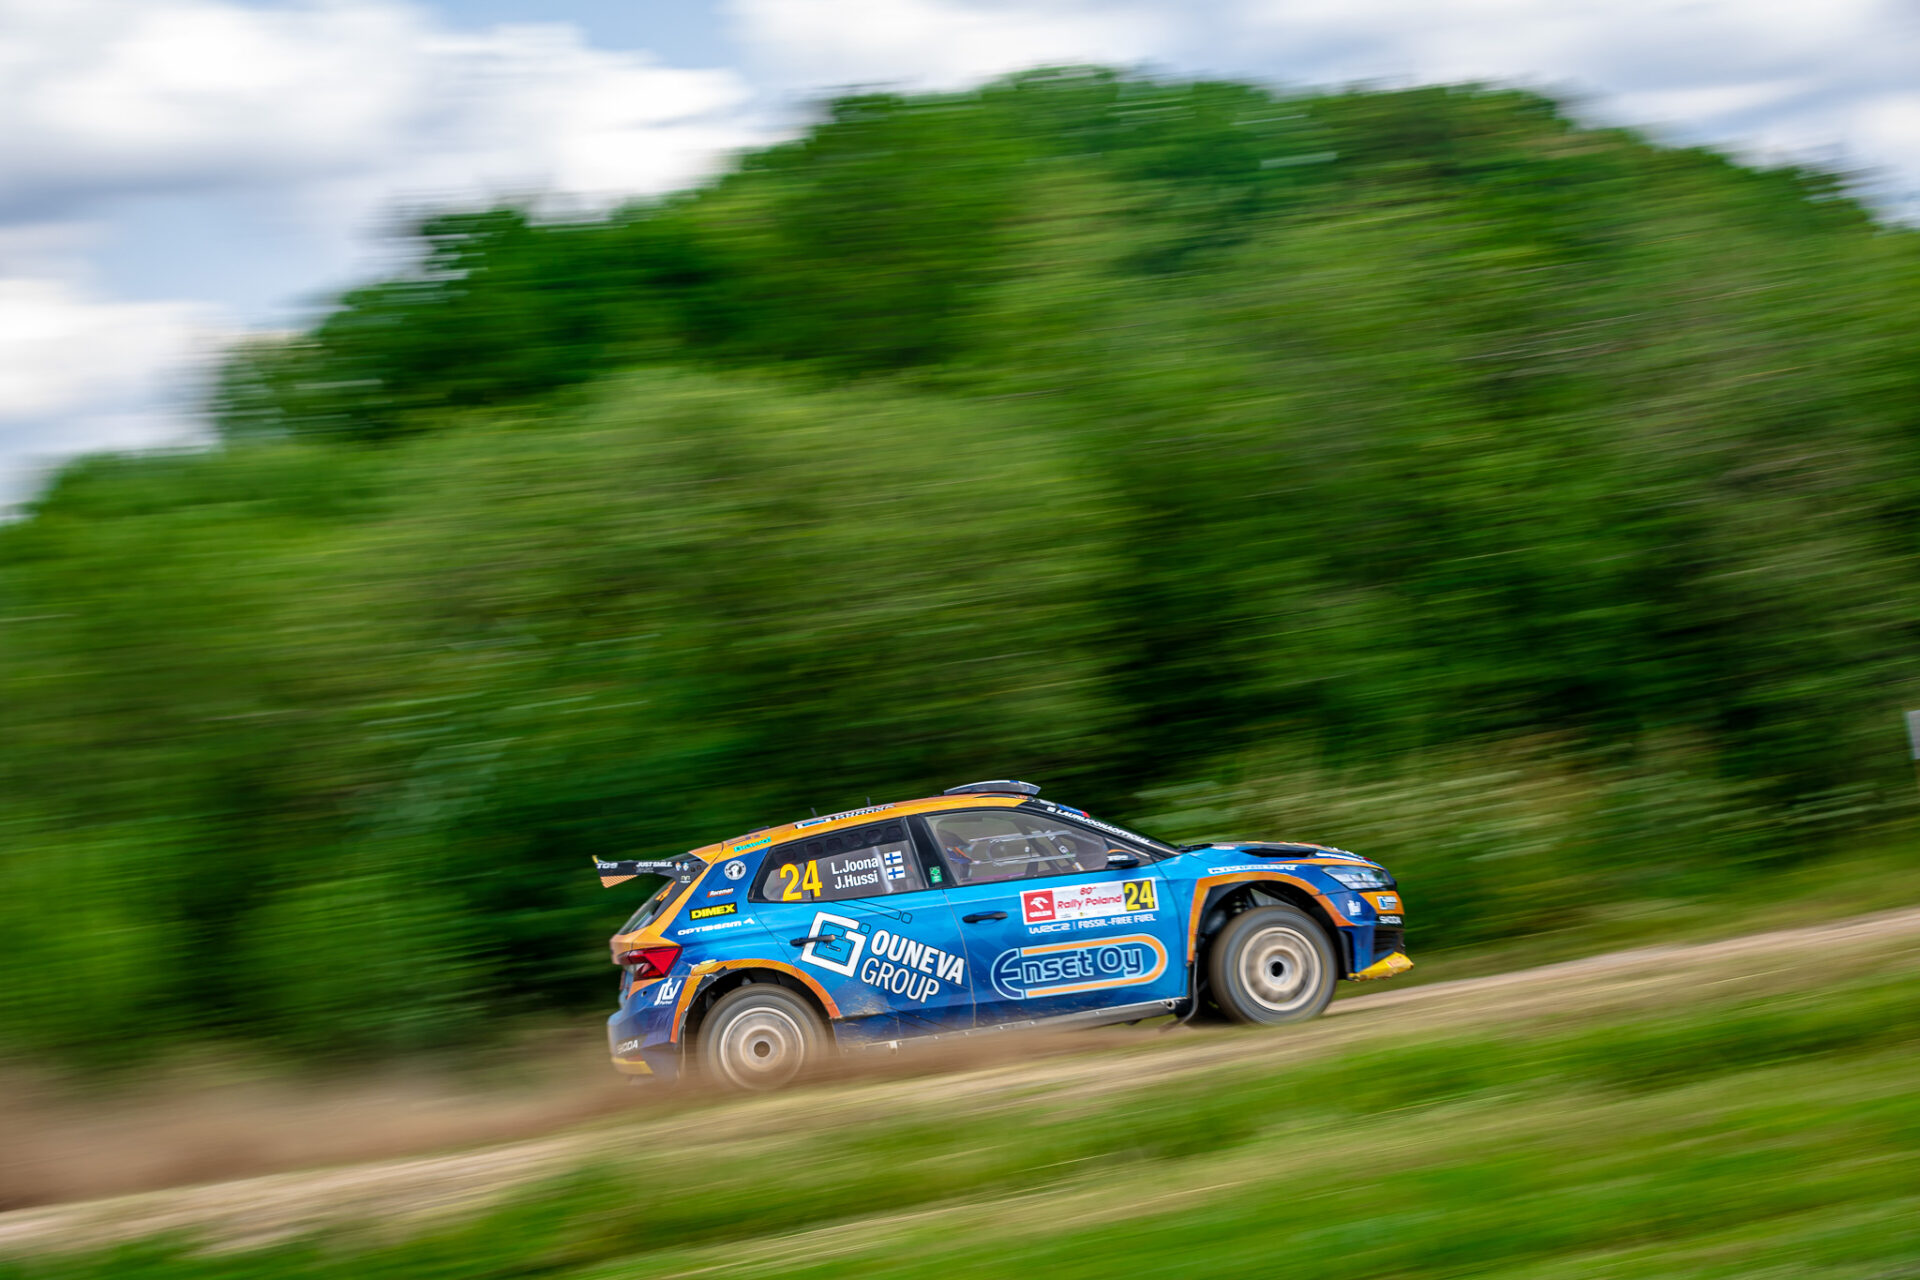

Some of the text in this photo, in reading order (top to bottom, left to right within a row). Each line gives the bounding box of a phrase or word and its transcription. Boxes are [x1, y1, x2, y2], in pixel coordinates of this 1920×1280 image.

[831, 857, 879, 875] L.Joona
[779, 859, 823, 902] 24
[834, 872, 879, 890] J.Hussi
[1057, 894, 1122, 910] Rally Poland
[1123, 880, 1155, 911] 24
[691, 903, 737, 920] DIMEX
[1028, 913, 1157, 935] WRC2 FOSSIL-FREE FUEL
[870, 929, 966, 985] OUNEVA
[860, 957, 940, 1003] GROUP
[990, 945, 1144, 1000] Enset Oy
